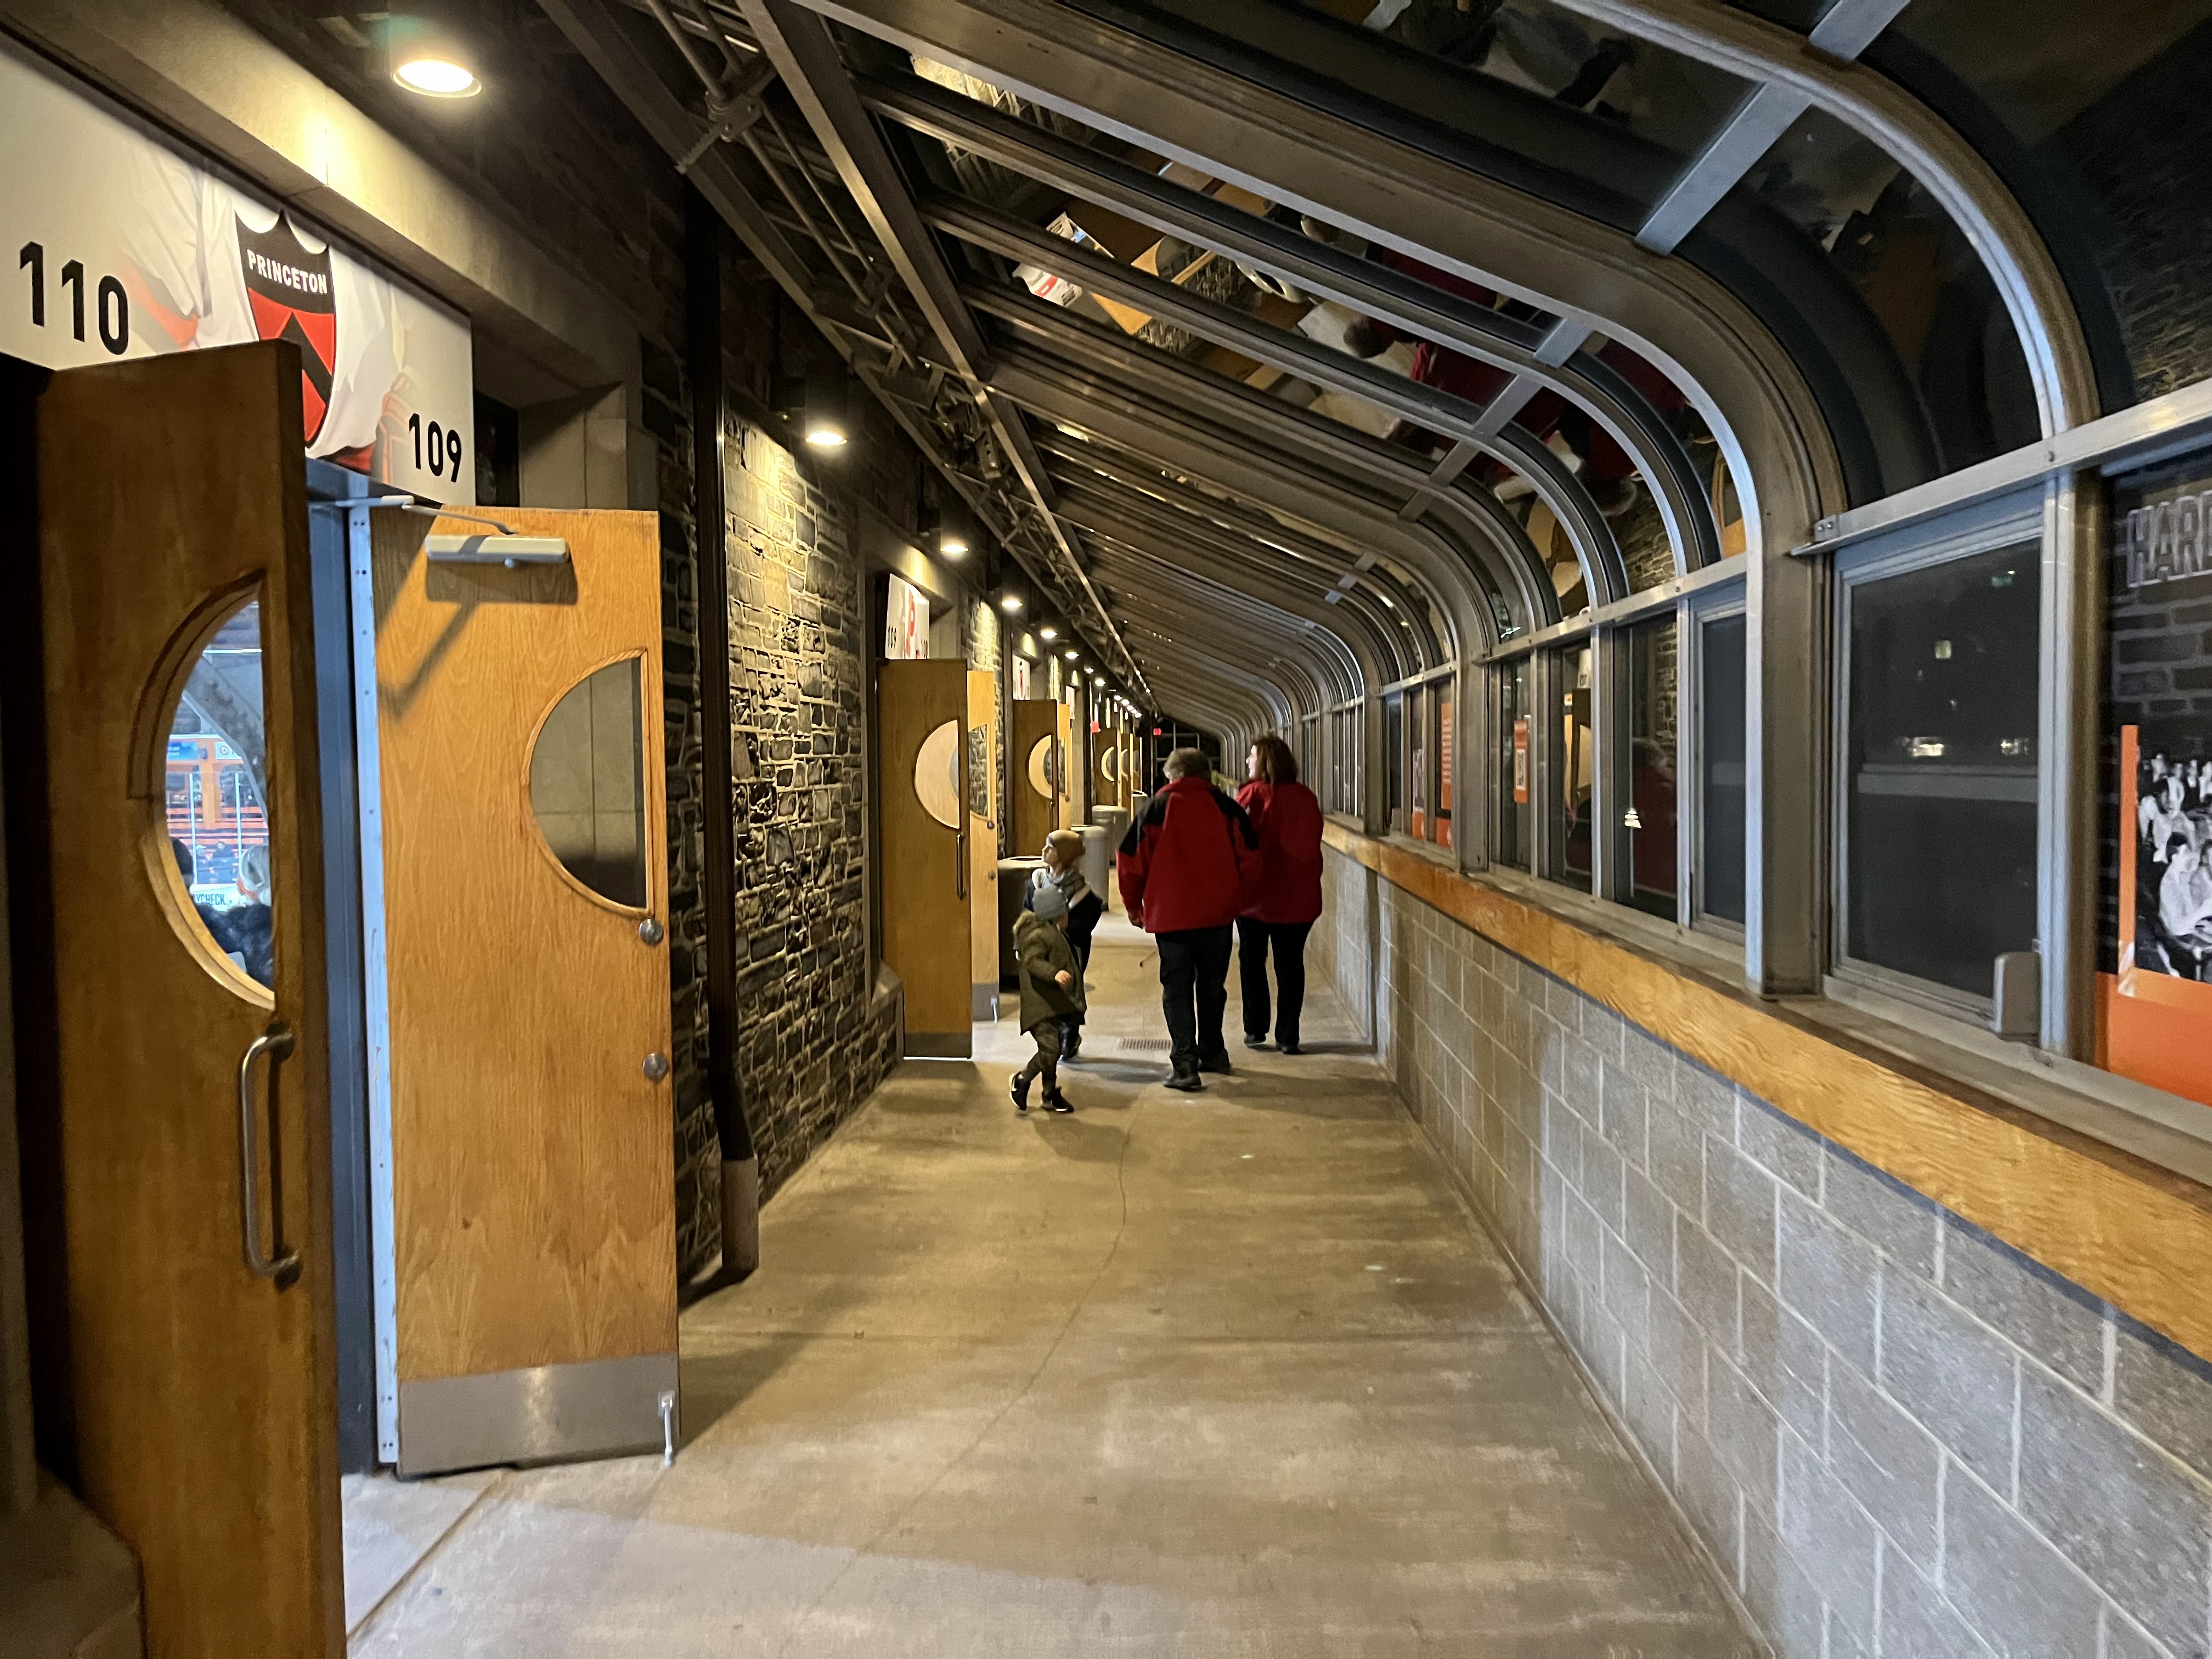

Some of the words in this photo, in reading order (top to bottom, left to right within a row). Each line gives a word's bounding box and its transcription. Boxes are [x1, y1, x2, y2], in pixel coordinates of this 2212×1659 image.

[20, 241, 129, 356] 110
[247, 249, 328, 294] PRINCETON
[409, 413, 461, 483] 109
[888, 625, 896, 649] 109
